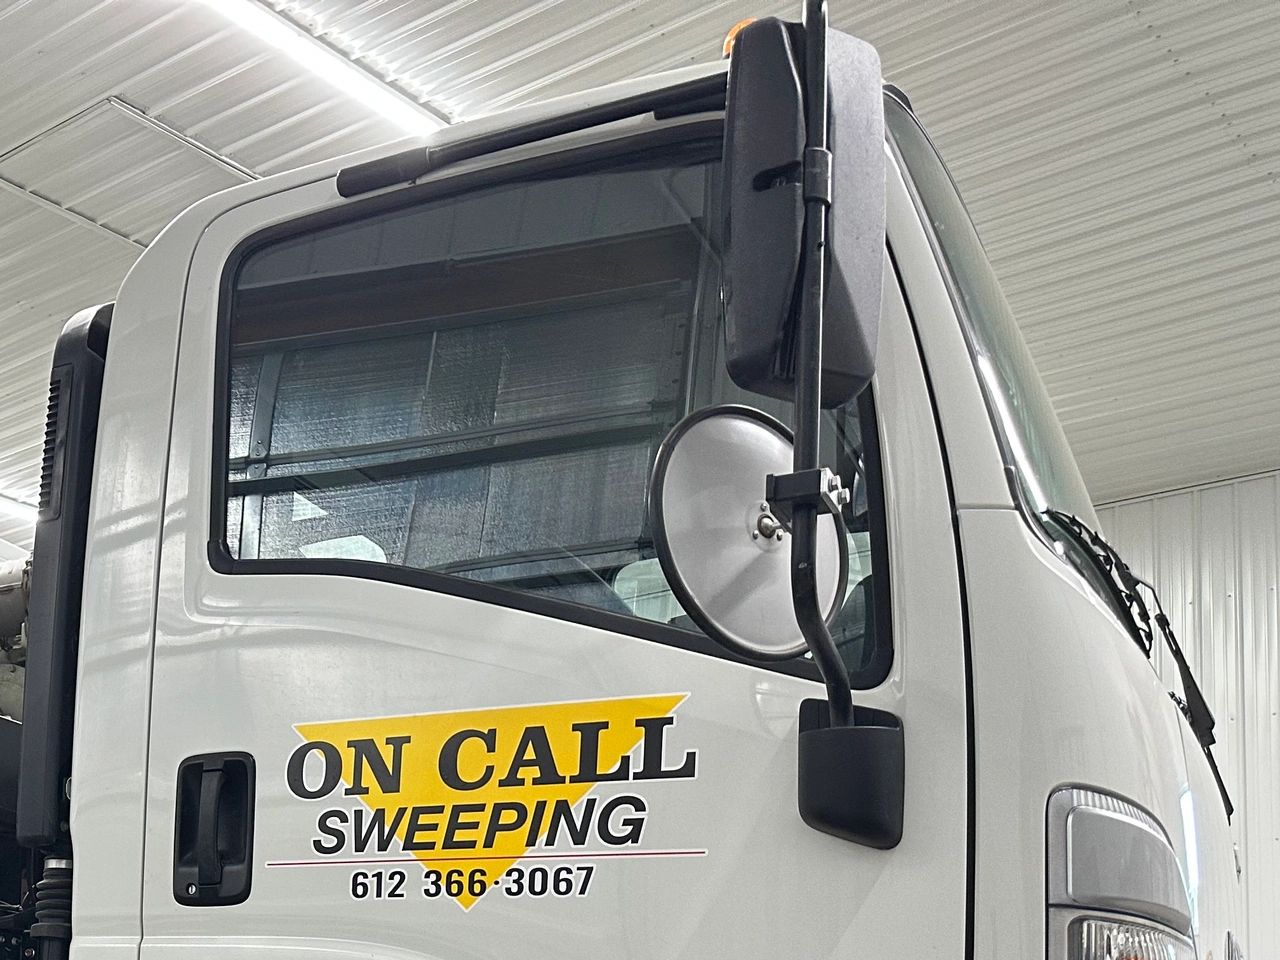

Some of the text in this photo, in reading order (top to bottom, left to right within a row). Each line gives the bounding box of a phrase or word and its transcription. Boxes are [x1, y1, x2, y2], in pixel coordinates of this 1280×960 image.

[286, 716, 697, 800] ON CALL
[312, 795, 647, 855] SWEEPING
[351, 870, 406, 899] 612
